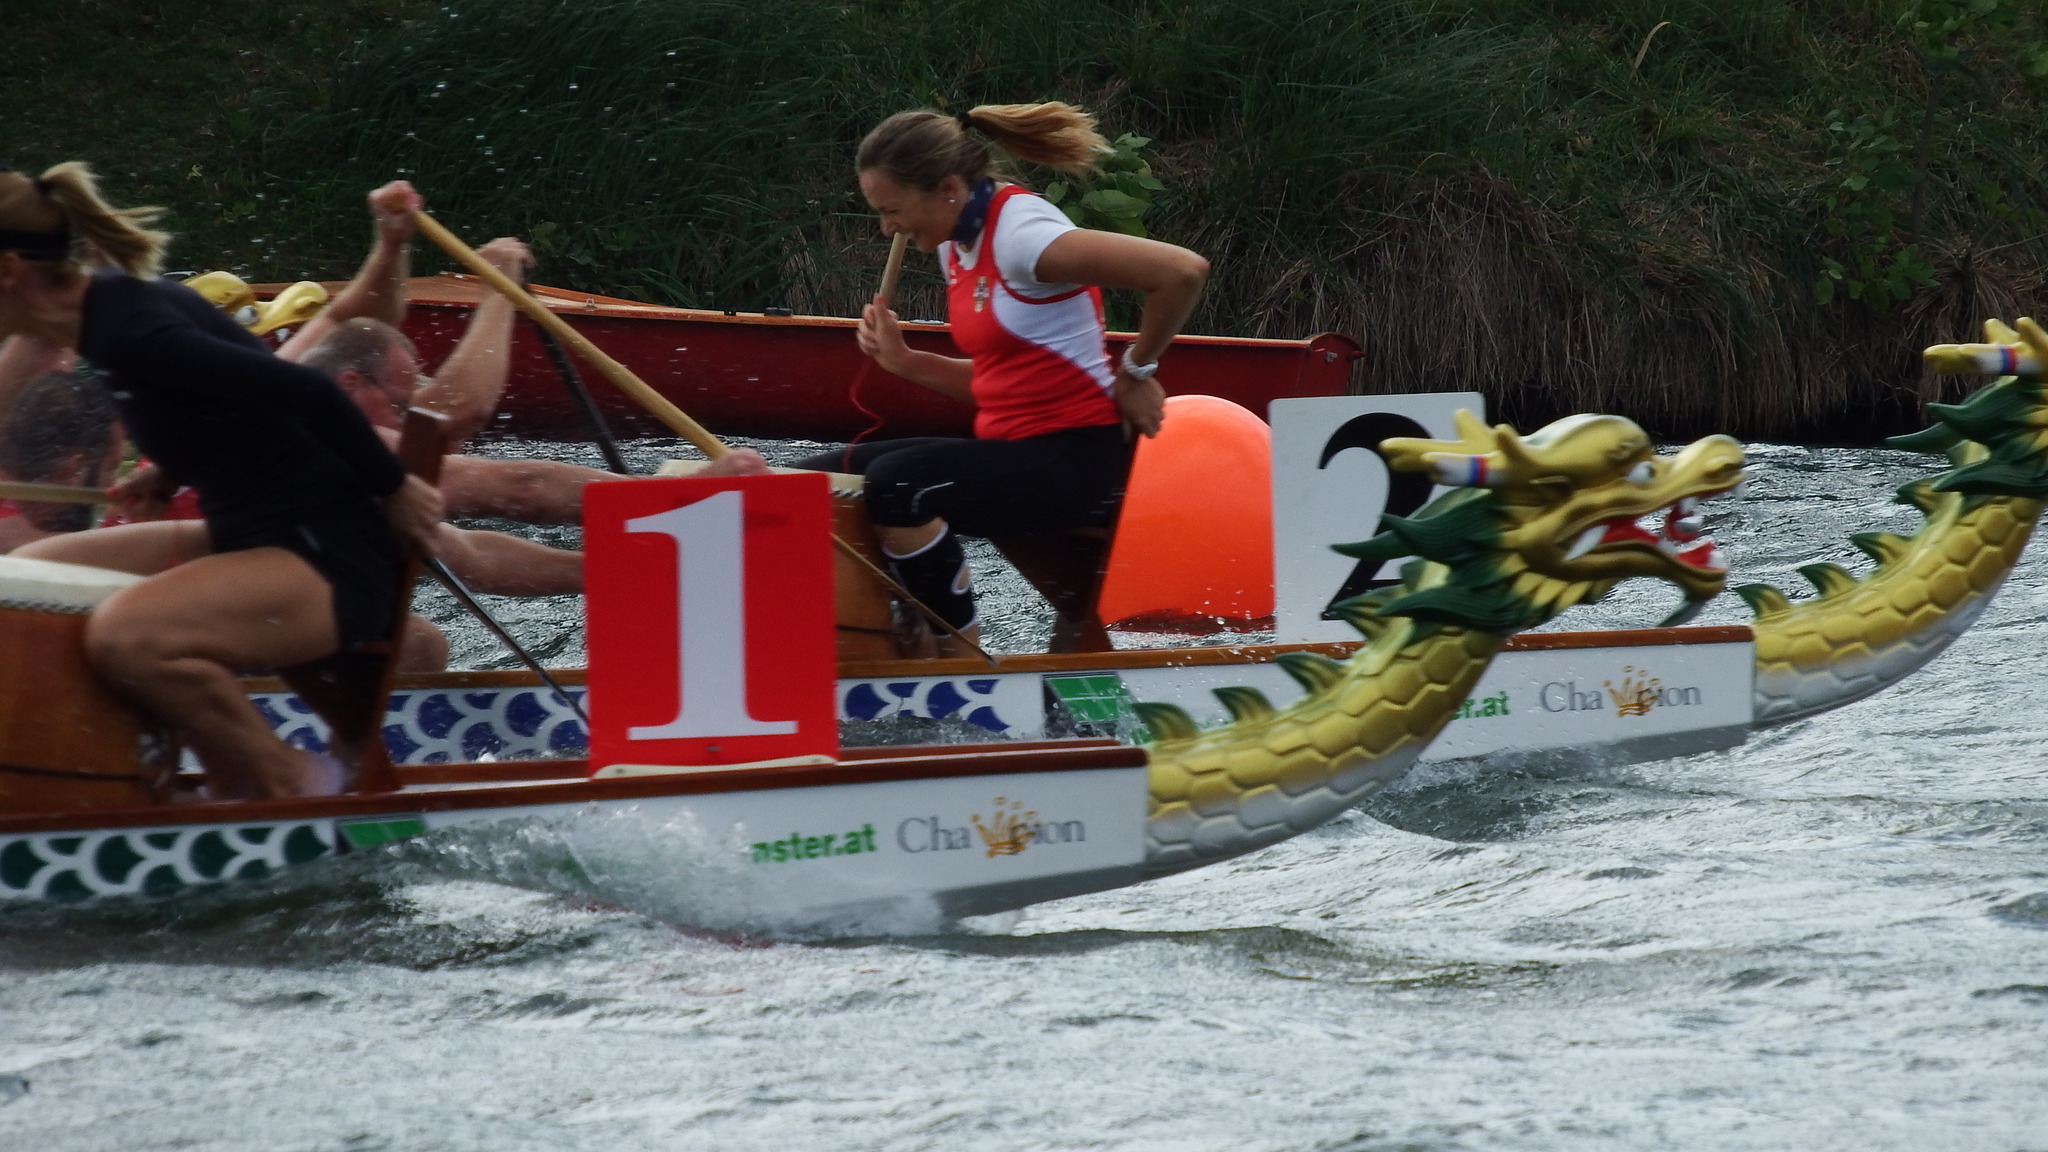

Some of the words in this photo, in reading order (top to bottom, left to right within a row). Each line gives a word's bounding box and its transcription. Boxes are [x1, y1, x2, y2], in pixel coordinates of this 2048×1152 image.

[1316, 411, 1437, 621] 2
[623, 489, 799, 741] 1
[1539, 680, 1702, 717] Chapion
[752, 823, 877, 863] nster.at
[896, 813, 1086, 857] Chapion
